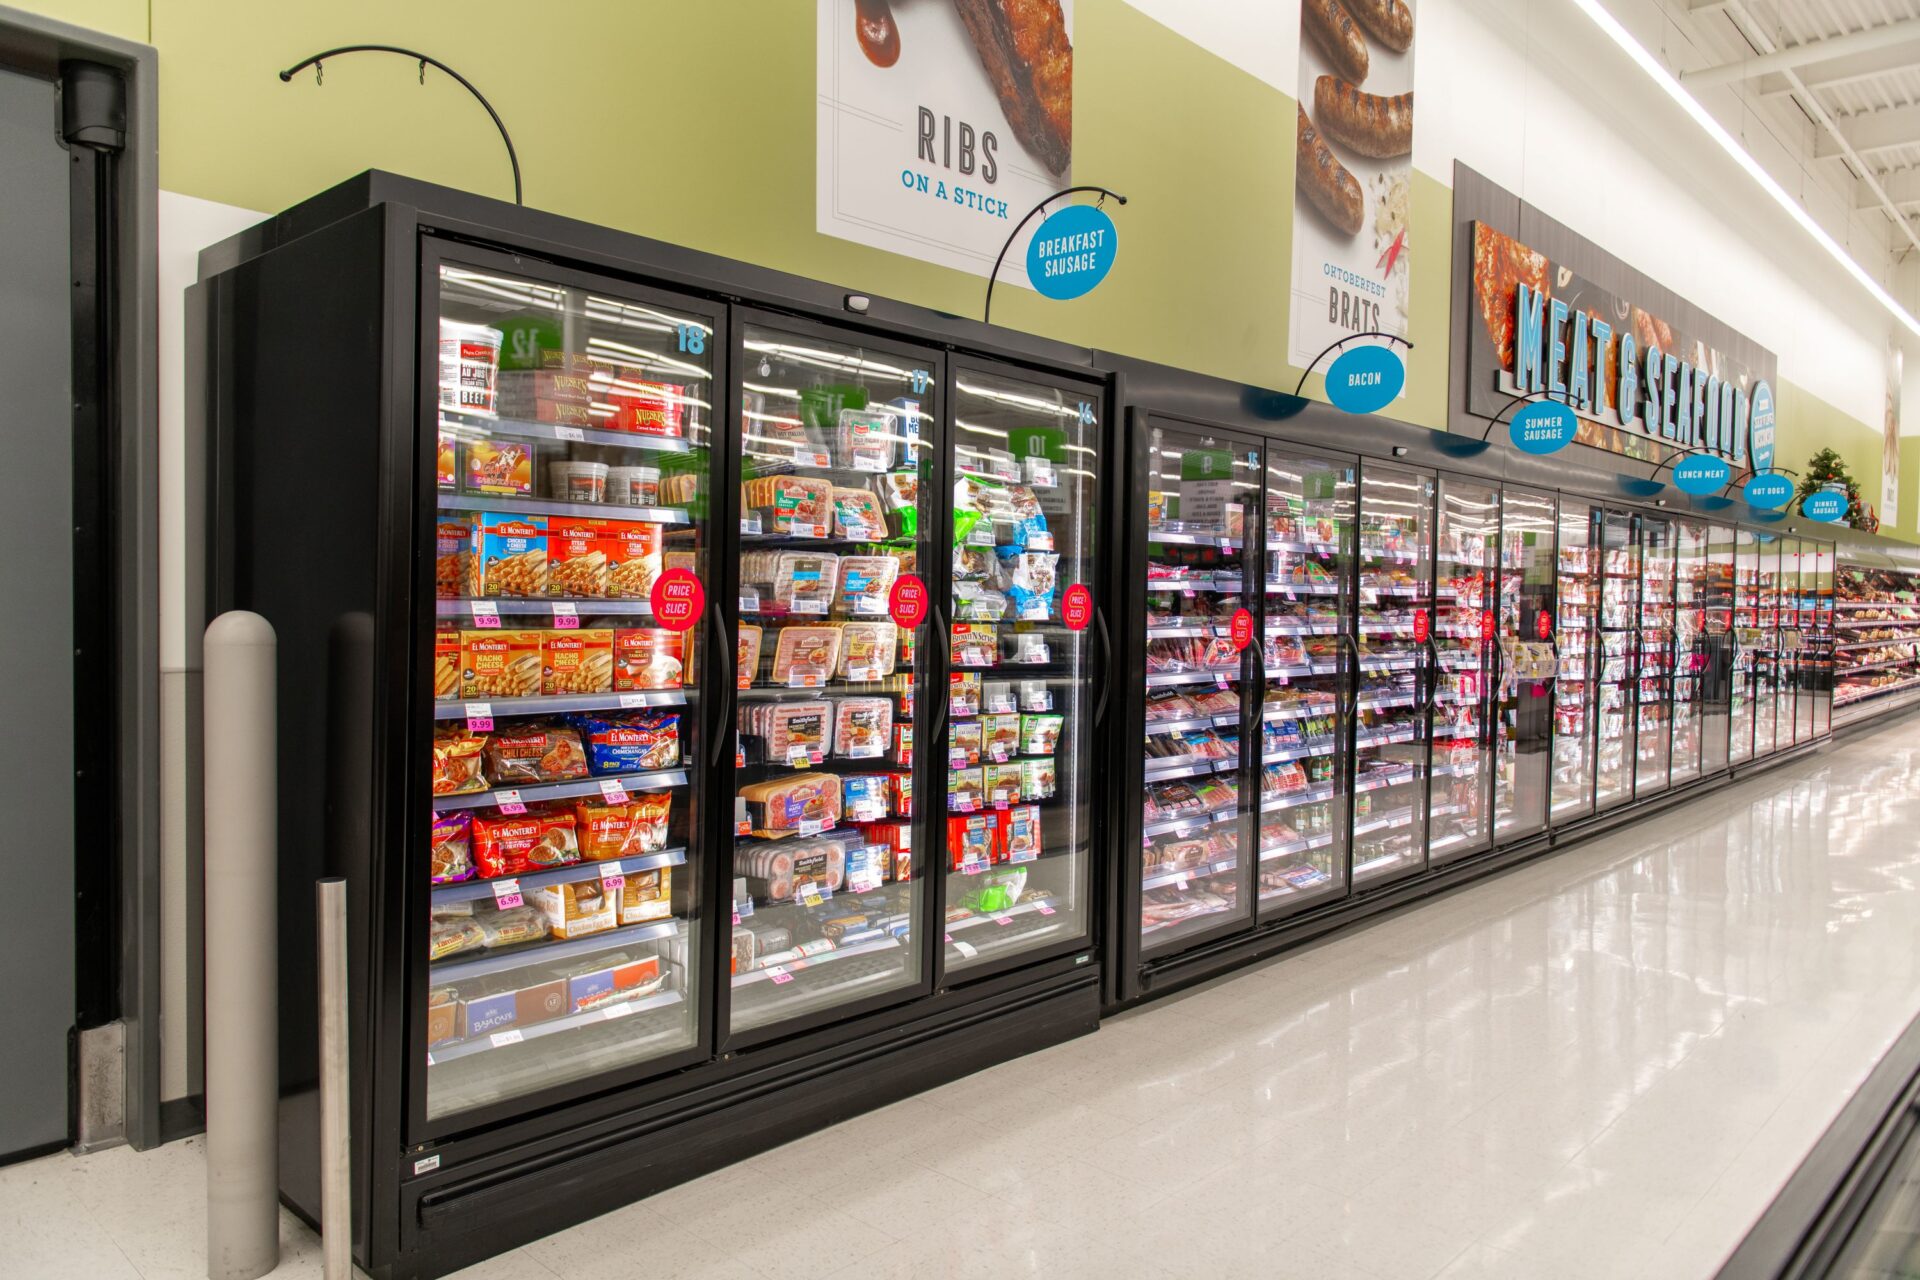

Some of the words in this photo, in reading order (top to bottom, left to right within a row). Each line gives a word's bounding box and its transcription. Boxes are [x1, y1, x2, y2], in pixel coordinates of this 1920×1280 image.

[917, 105, 998, 184] RIBS
[901, 169, 928, 193] ON
[935, 181, 948, 200] A
[954, 187, 1008, 219] STICK
[1039, 229, 1104, 258] BREAKFAST
[1045, 252, 1096, 278] SAUSAGE
[1324, 263, 1386, 298] OKTOBERFEST
[1329, 286, 1380, 339] BRATS
[677, 323, 705, 355] 18
[1515, 281, 1611, 415] MEAT
[1617, 332, 1638, 426] &
[1643, 345, 1748, 462] SEAFOOD
[912, 369, 929, 395] 17
[1348, 372, 1381, 387] BACON
[461, 391, 486, 404] BEEF
[1078, 400, 1093, 425] 16
[1525, 416, 1563, 429] SUMMER
[1524, 428, 1563, 441] SAUSAGE
[1678, 470, 1703, 479] LUNCH
[1704, 470, 1725, 479] MEAT
[1767, 487, 1785, 495] DOGS
[1814, 500, 1838, 508] DINNER
[1812, 506, 1839, 514] SAUSAGE
[508, 527, 534, 535] MONTEREY
[570, 530, 594, 539] MONTEREY
[627, 533, 650, 541] MONTEREY
[667, 584, 690, 597] PRICE
[901, 588, 919, 599] PRICE
[1071, 595, 1085, 605] PRICE
[665, 602, 687, 615] SLICE
[899, 604, 916, 614] SLICE
[1069, 609, 1083, 618] SLICE
[478, 617, 498, 625] 9.99
[558, 617, 577, 626] 9.99
[472, 642, 479, 651] EL
[479, 643, 507, 651] MONTEREY
[557, 641, 582, 649] MONTEREY
[630, 639, 654, 647] MONTEREY
[476, 654, 503, 662] NACHO
[553, 659, 580, 667] CHEESE
[475, 661, 505, 670] CHEESE
[545, 681, 554, 689] 20
[471, 720, 491, 729] 9.99
[792, 716, 818, 724] Smithfield
[611, 734, 619, 742] EL
[618, 733, 649, 742] MONTEREY
[502, 747, 519, 758] CHILI
[520, 747, 543, 758] CHEESE
[503, 804, 522, 812] 6.99
[592, 821, 600, 830] EL
[600, 821, 629, 829] MONTEREY
[492, 829, 501, 838] EL
[501, 826, 537, 837] MONTEREY
[605, 878, 623, 888] 6.99
[500, 895, 519, 905] 6.99
[473, 1017, 494, 1032] BAJA
